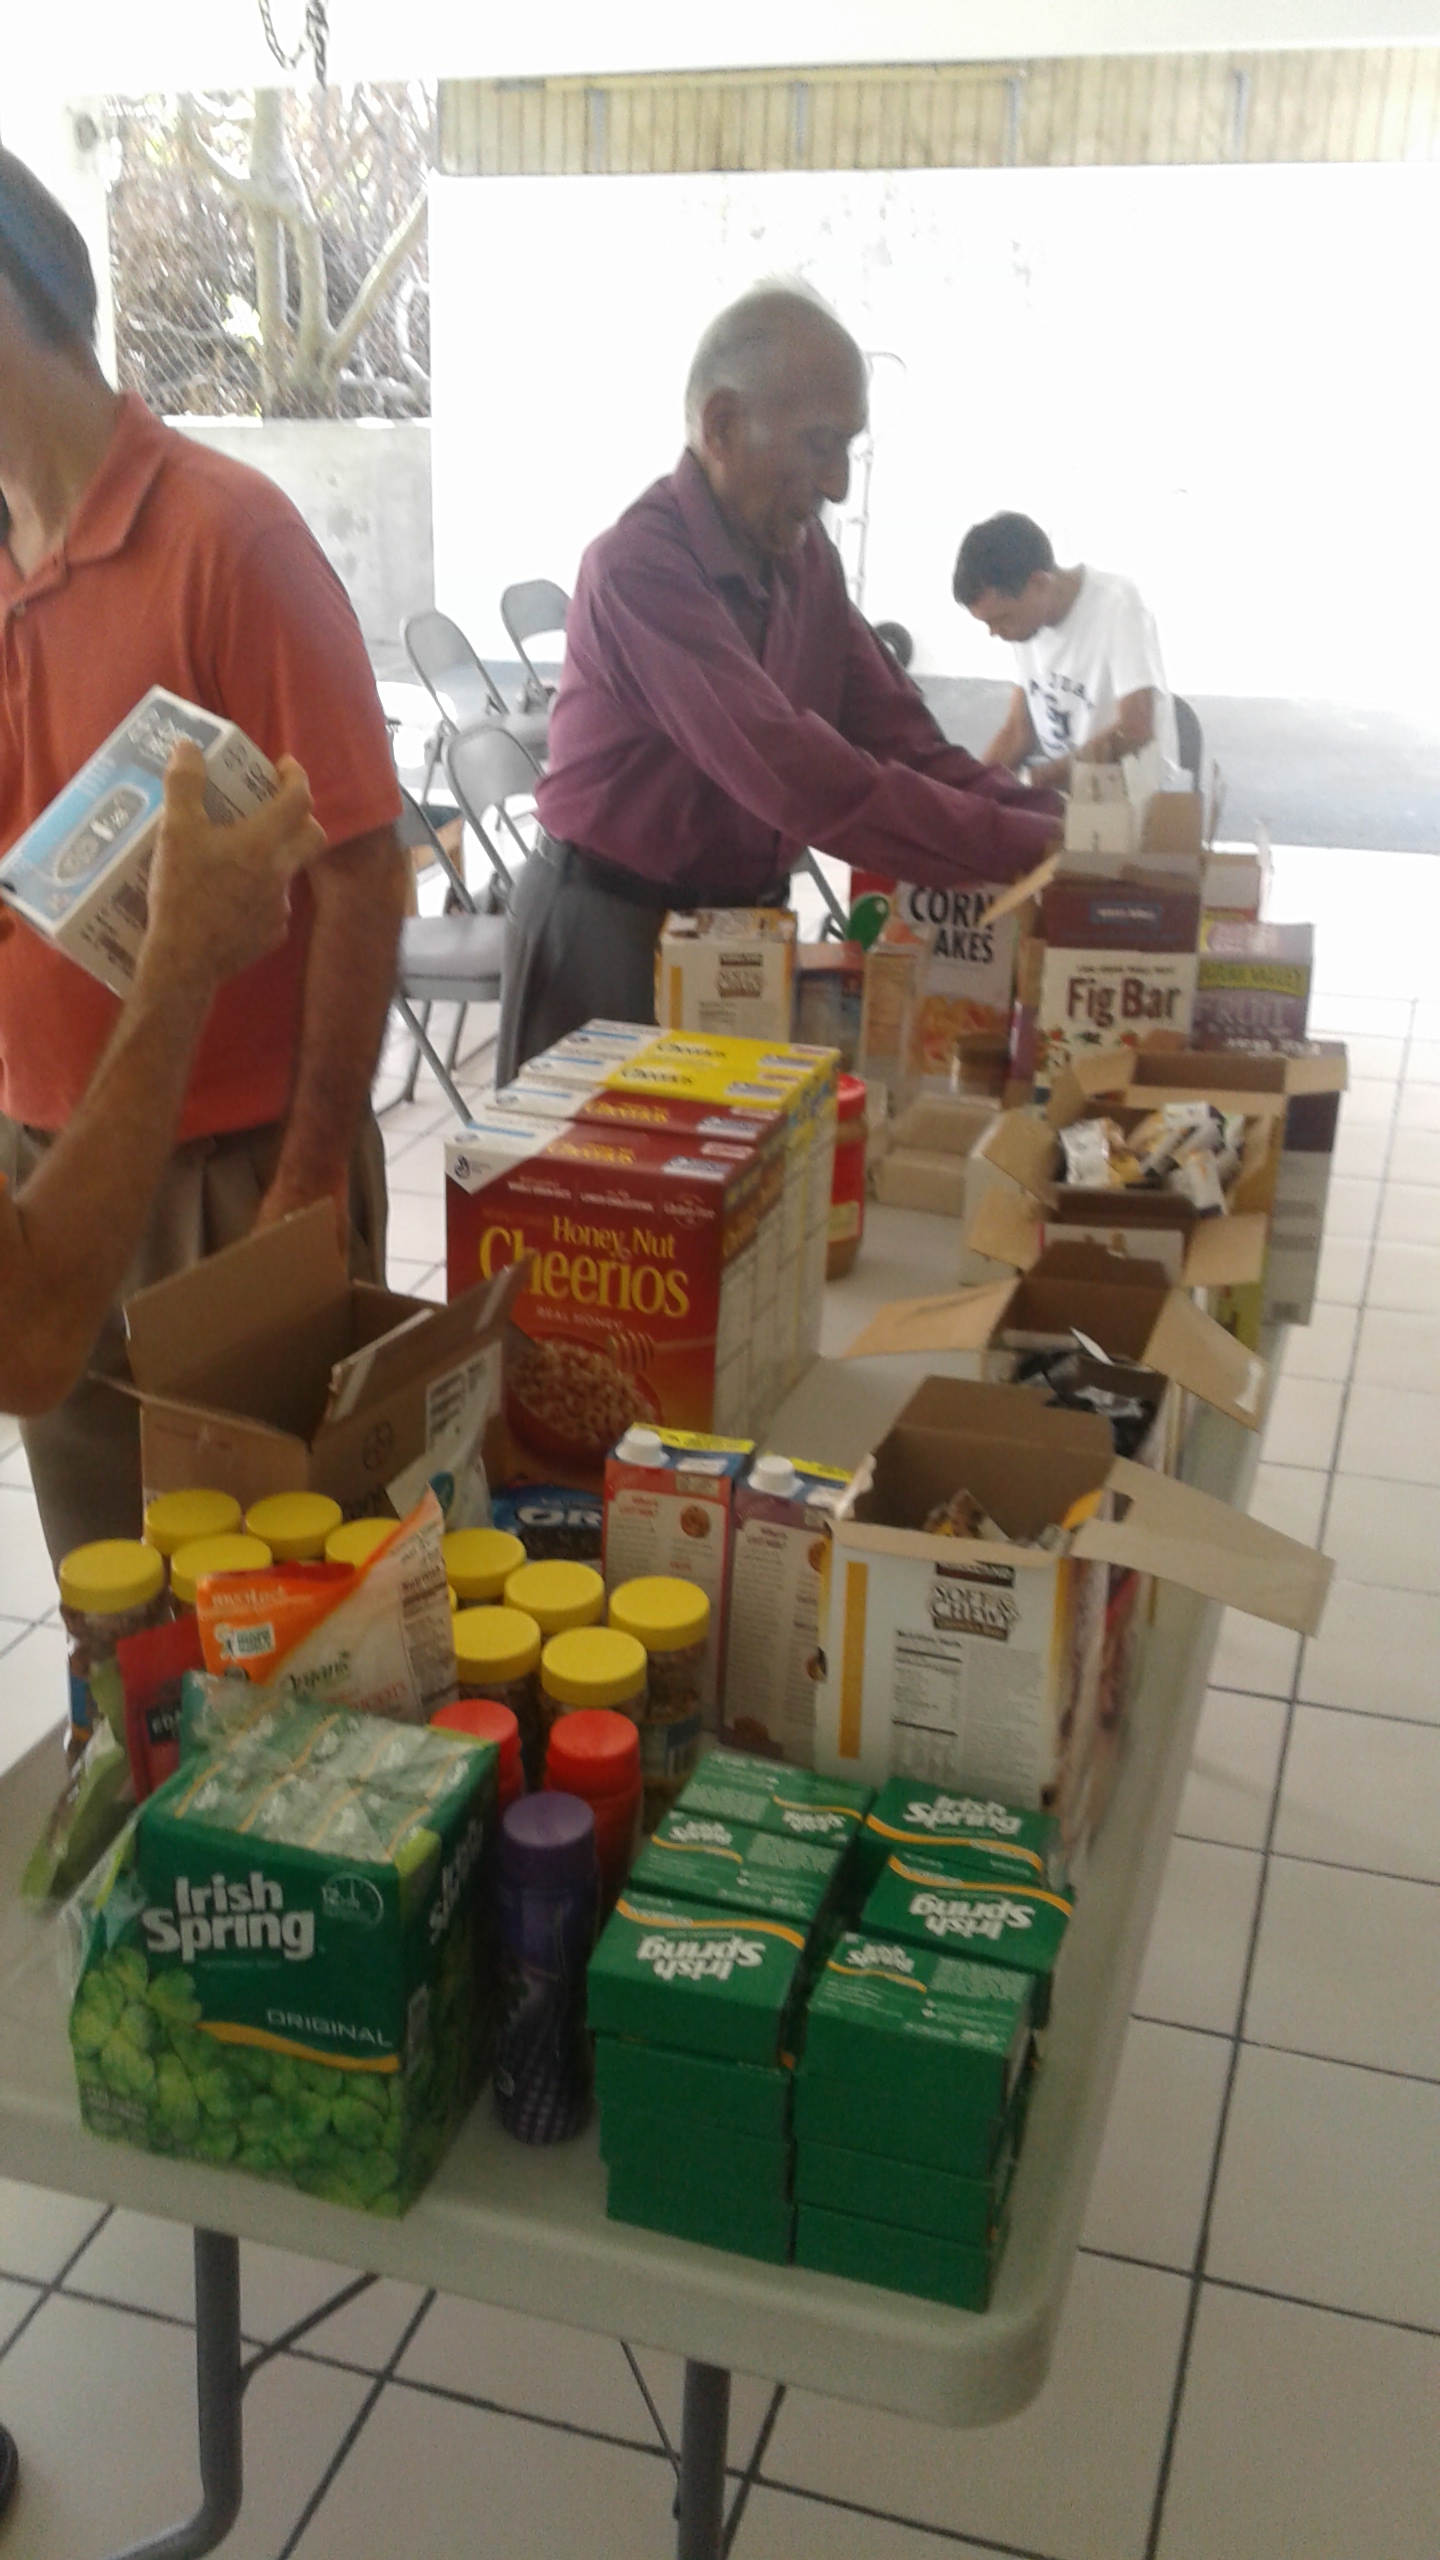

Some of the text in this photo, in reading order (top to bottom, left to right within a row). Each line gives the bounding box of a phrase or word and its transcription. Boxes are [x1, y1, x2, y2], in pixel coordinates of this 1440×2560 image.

[933, 929, 993, 964] AKES
[1067, 977, 1116, 1028] Fig
[1121, 977, 1181, 1019] Bar
[552, 1214, 676, 1260] Honey Nut
[479, 1225, 690, 1320] Cheerios
[516, 1505, 603, 1530] OR
[902, 1802, 1023, 1836] Spring
[175, 1870, 284, 1915] Irish
[909, 1892, 1036, 1929] Spring
[142, 1907, 316, 1964] Spring
[637, 1934, 767, 1968] Spring
[266, 2008, 394, 2049] ORIGINAL
